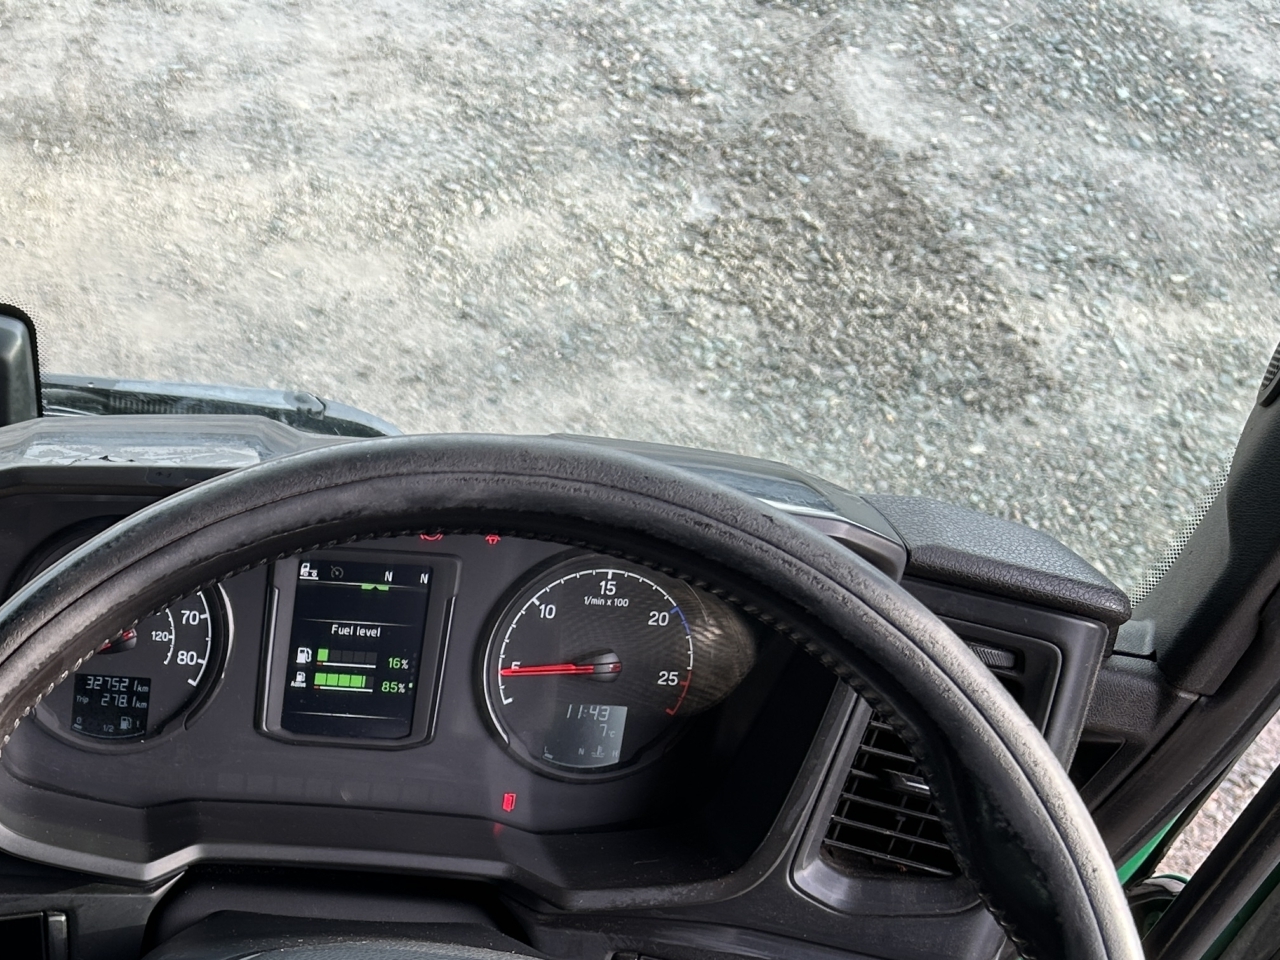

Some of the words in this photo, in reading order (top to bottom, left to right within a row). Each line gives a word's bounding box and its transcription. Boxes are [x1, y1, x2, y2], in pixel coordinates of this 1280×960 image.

[384, 570, 394, 582] N
[420, 573, 429, 584] N
[599, 580, 616, 596] 15
[584, 595, 605, 606] 1/min
[614, 598, 629, 607] 100
[181, 610, 200, 625] 70
[538, 604, 556, 619] 10
[648, 611, 669, 626] 20
[151, 630, 169, 642] 120
[331, 624, 354, 636] Fuel
[356, 625, 381, 638] level
[176, 650, 197, 665] 80
[388, 657, 409, 670] 16%
[657, 671, 679, 686] 25
[381, 681, 406, 694] 85%
[76, 695, 89, 704] Trip
[566, 704, 610, 721] 11:43
[103, 724, 114, 733] 1/2
